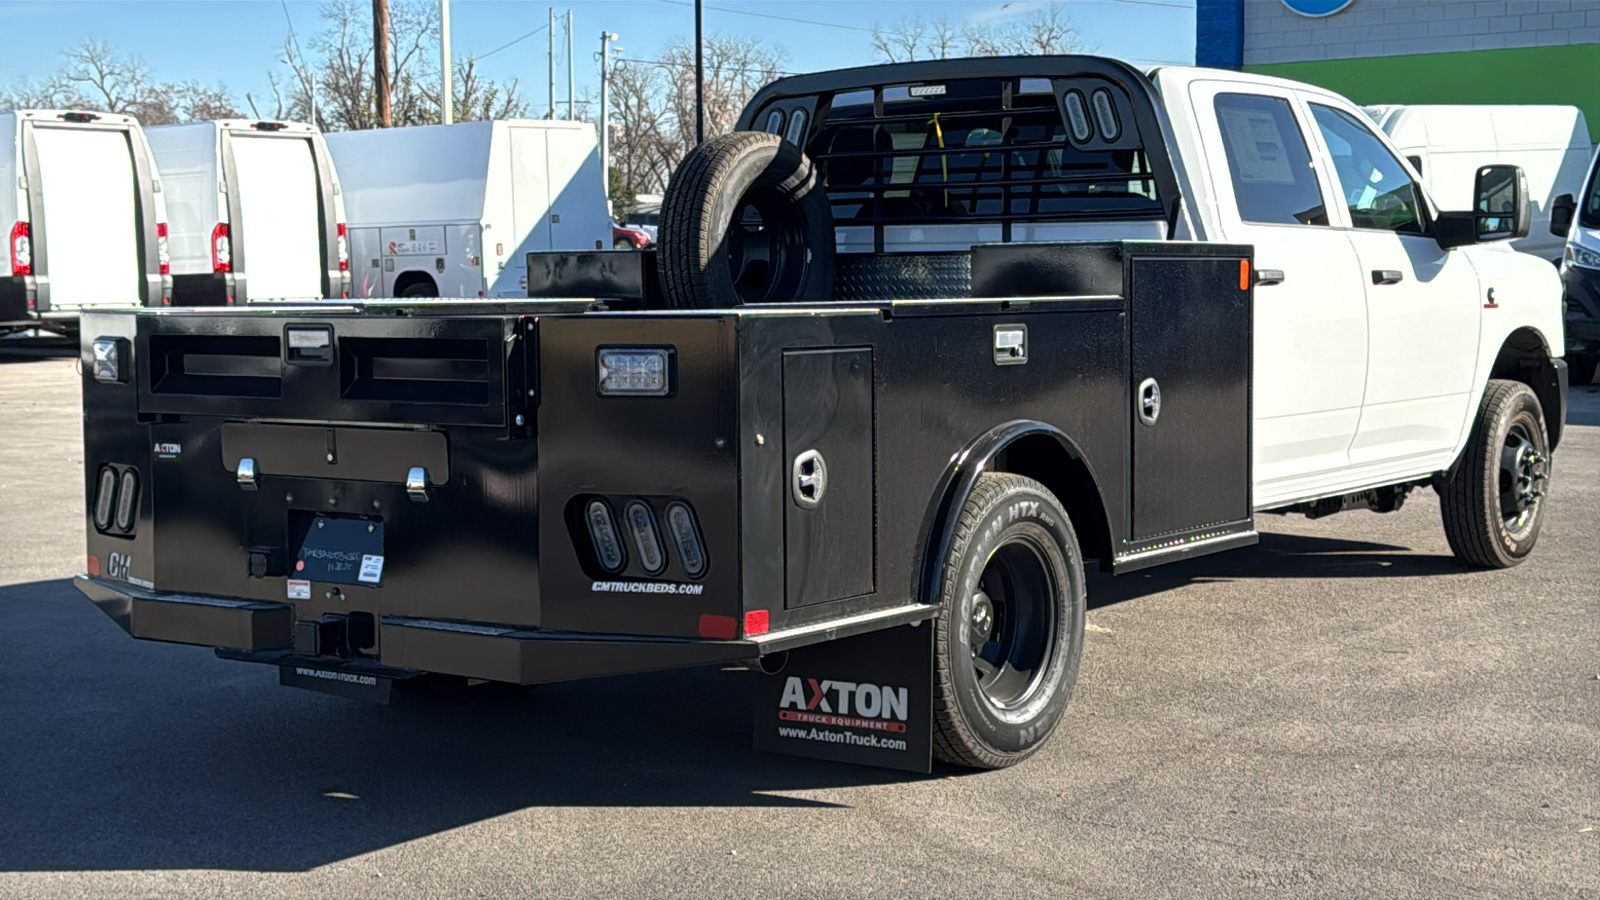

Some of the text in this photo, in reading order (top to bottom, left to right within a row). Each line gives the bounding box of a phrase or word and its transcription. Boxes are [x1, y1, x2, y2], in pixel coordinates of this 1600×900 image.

[154, 443, 182, 453] AXTON
[108, 552, 132, 580] CM
[959, 515, 1003, 645] ROADIAN
[1008, 501, 1040, 522] HTX
[591, 581, 704, 595] CMTRUCKBEDS.COM
[779, 676, 908, 721] AXTON
[797, 713, 888, 730] TRUCK EQUIPMENT
[778, 726, 907, 751] www.AxtonTruck.com
